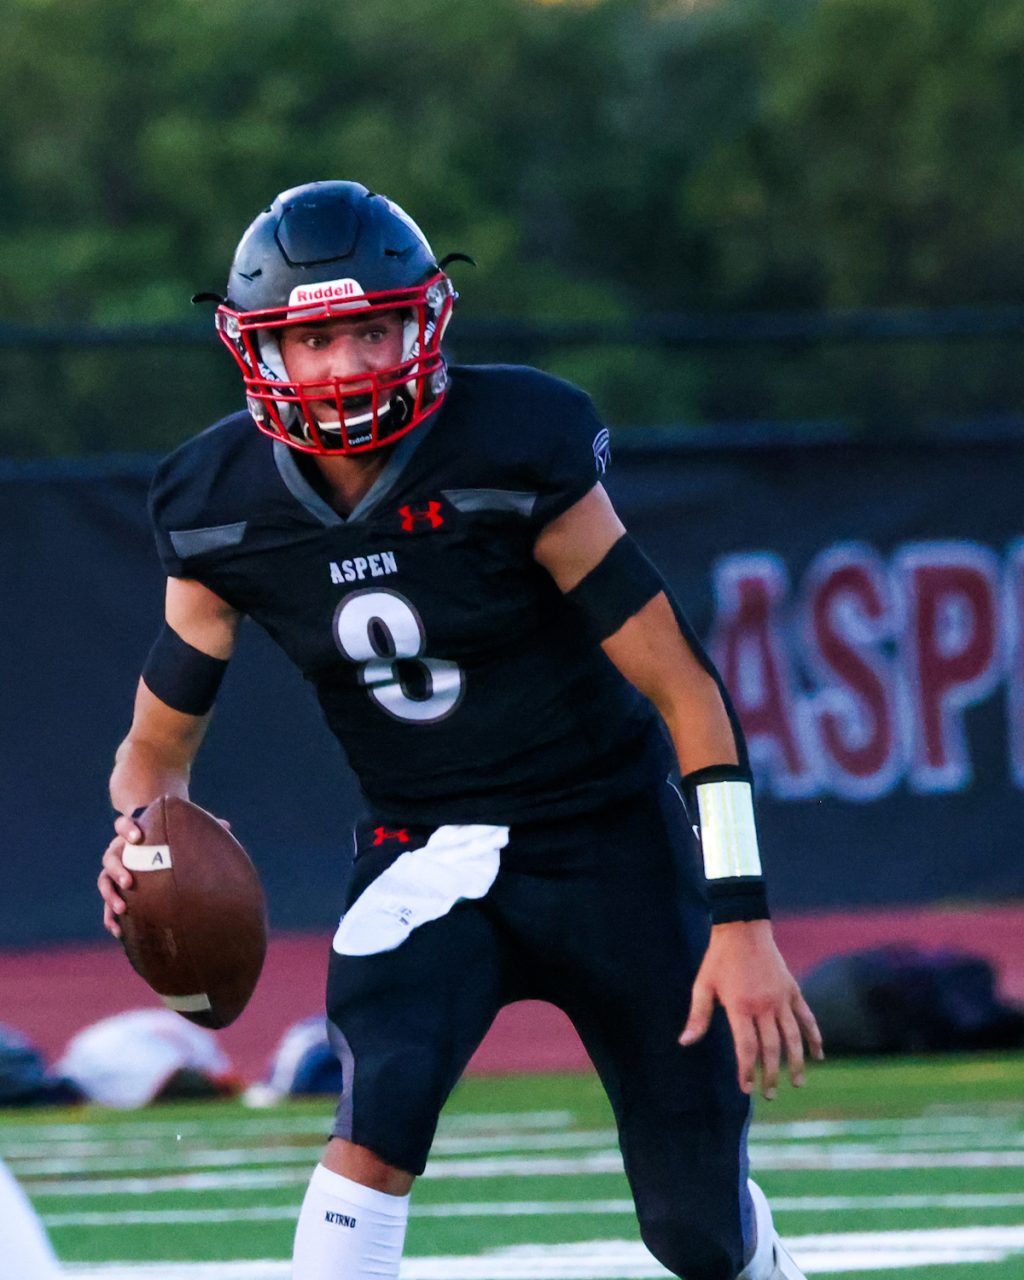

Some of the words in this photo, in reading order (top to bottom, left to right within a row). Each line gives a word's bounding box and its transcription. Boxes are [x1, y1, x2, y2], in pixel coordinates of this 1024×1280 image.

[296, 282, 354, 302] Riddell
[329, 551, 399, 584] ASPEN
[331, 585, 466, 726] 8
[709, 540, 1024, 799] ASP
[151, 850, 164, 866] A
